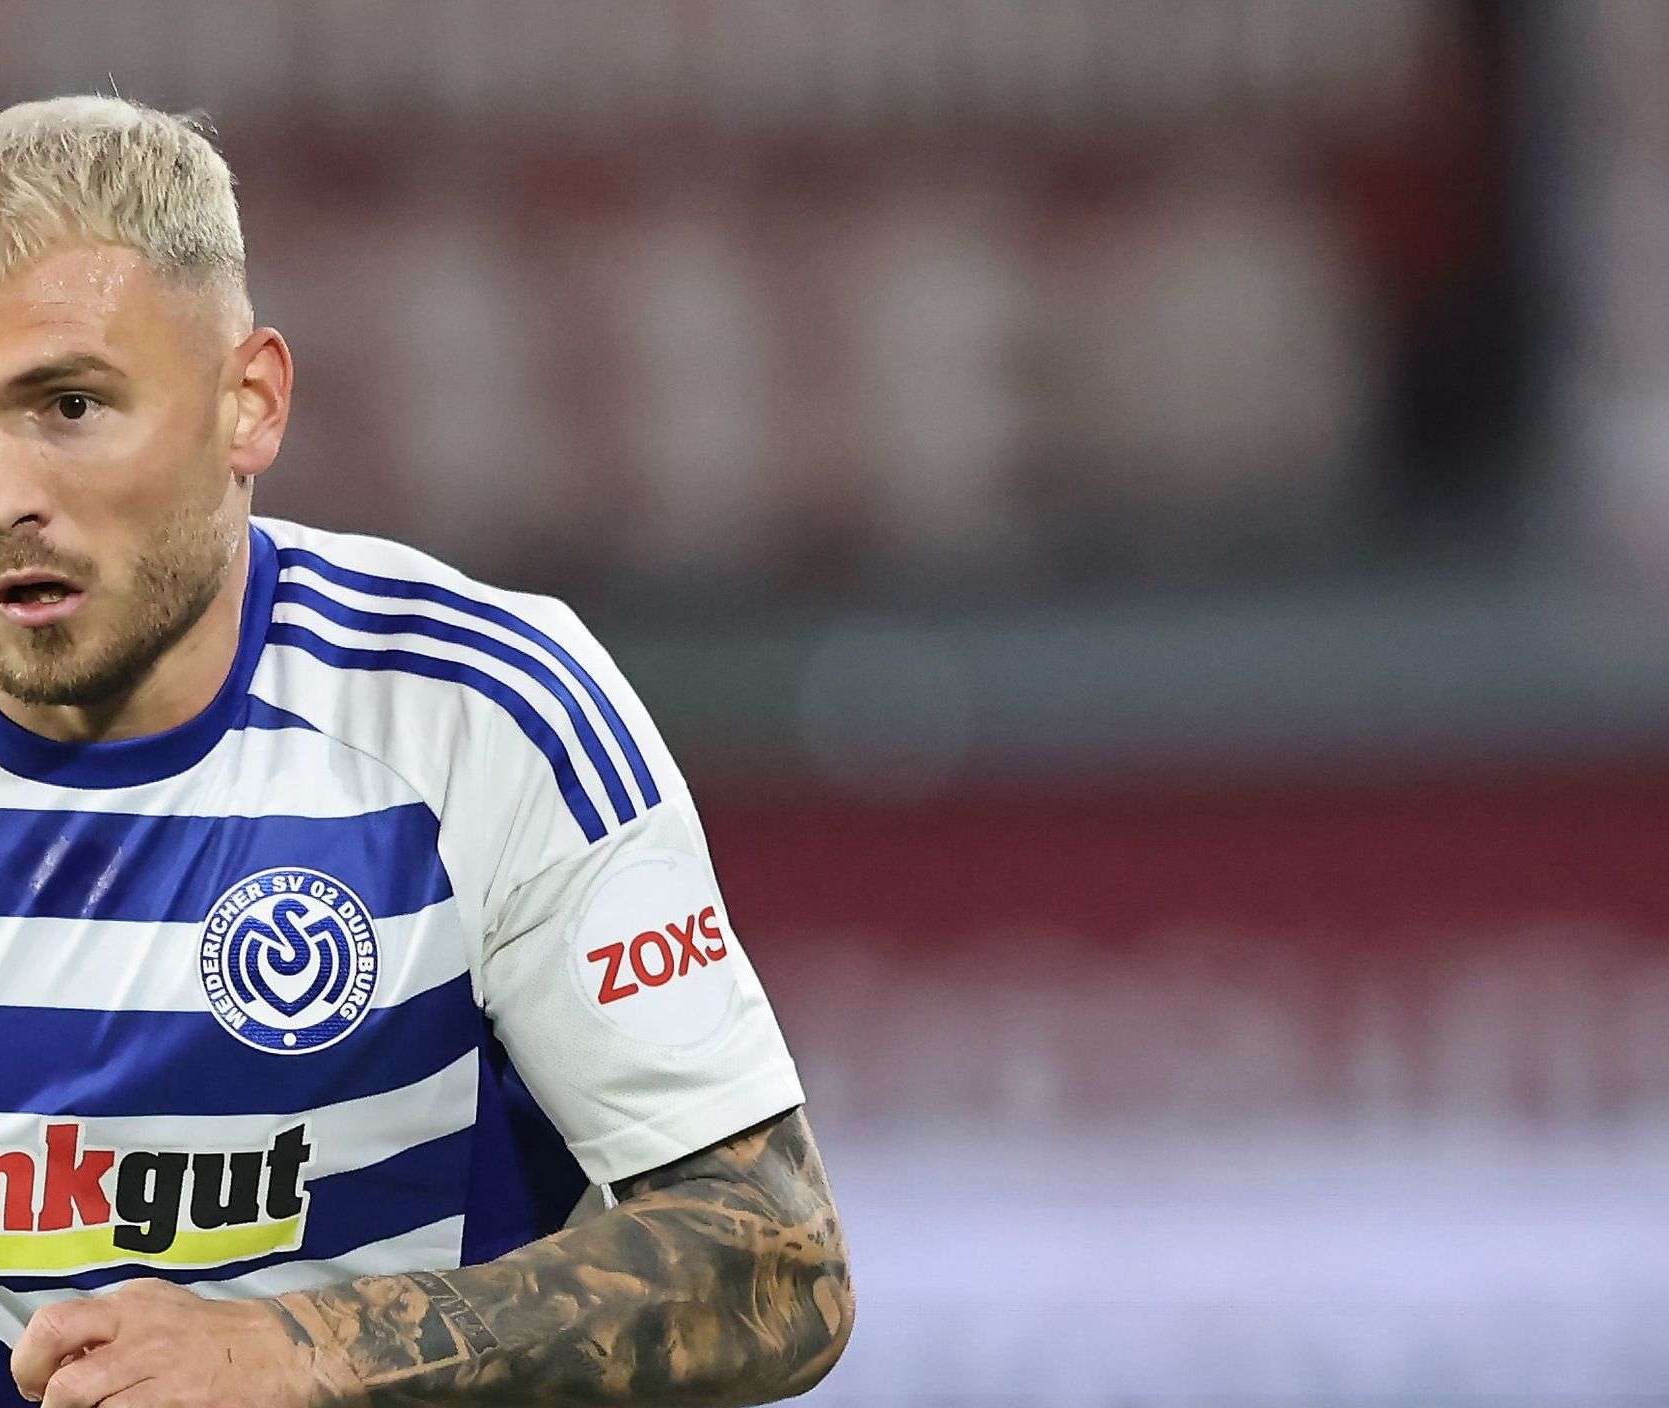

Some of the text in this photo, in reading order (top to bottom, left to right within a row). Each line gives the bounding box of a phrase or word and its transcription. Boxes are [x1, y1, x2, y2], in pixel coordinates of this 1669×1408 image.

[202, 874, 375, 1031] MEIDERICHER SV 02 DUISBURG
[586, 905, 728, 1005] ZOXS
